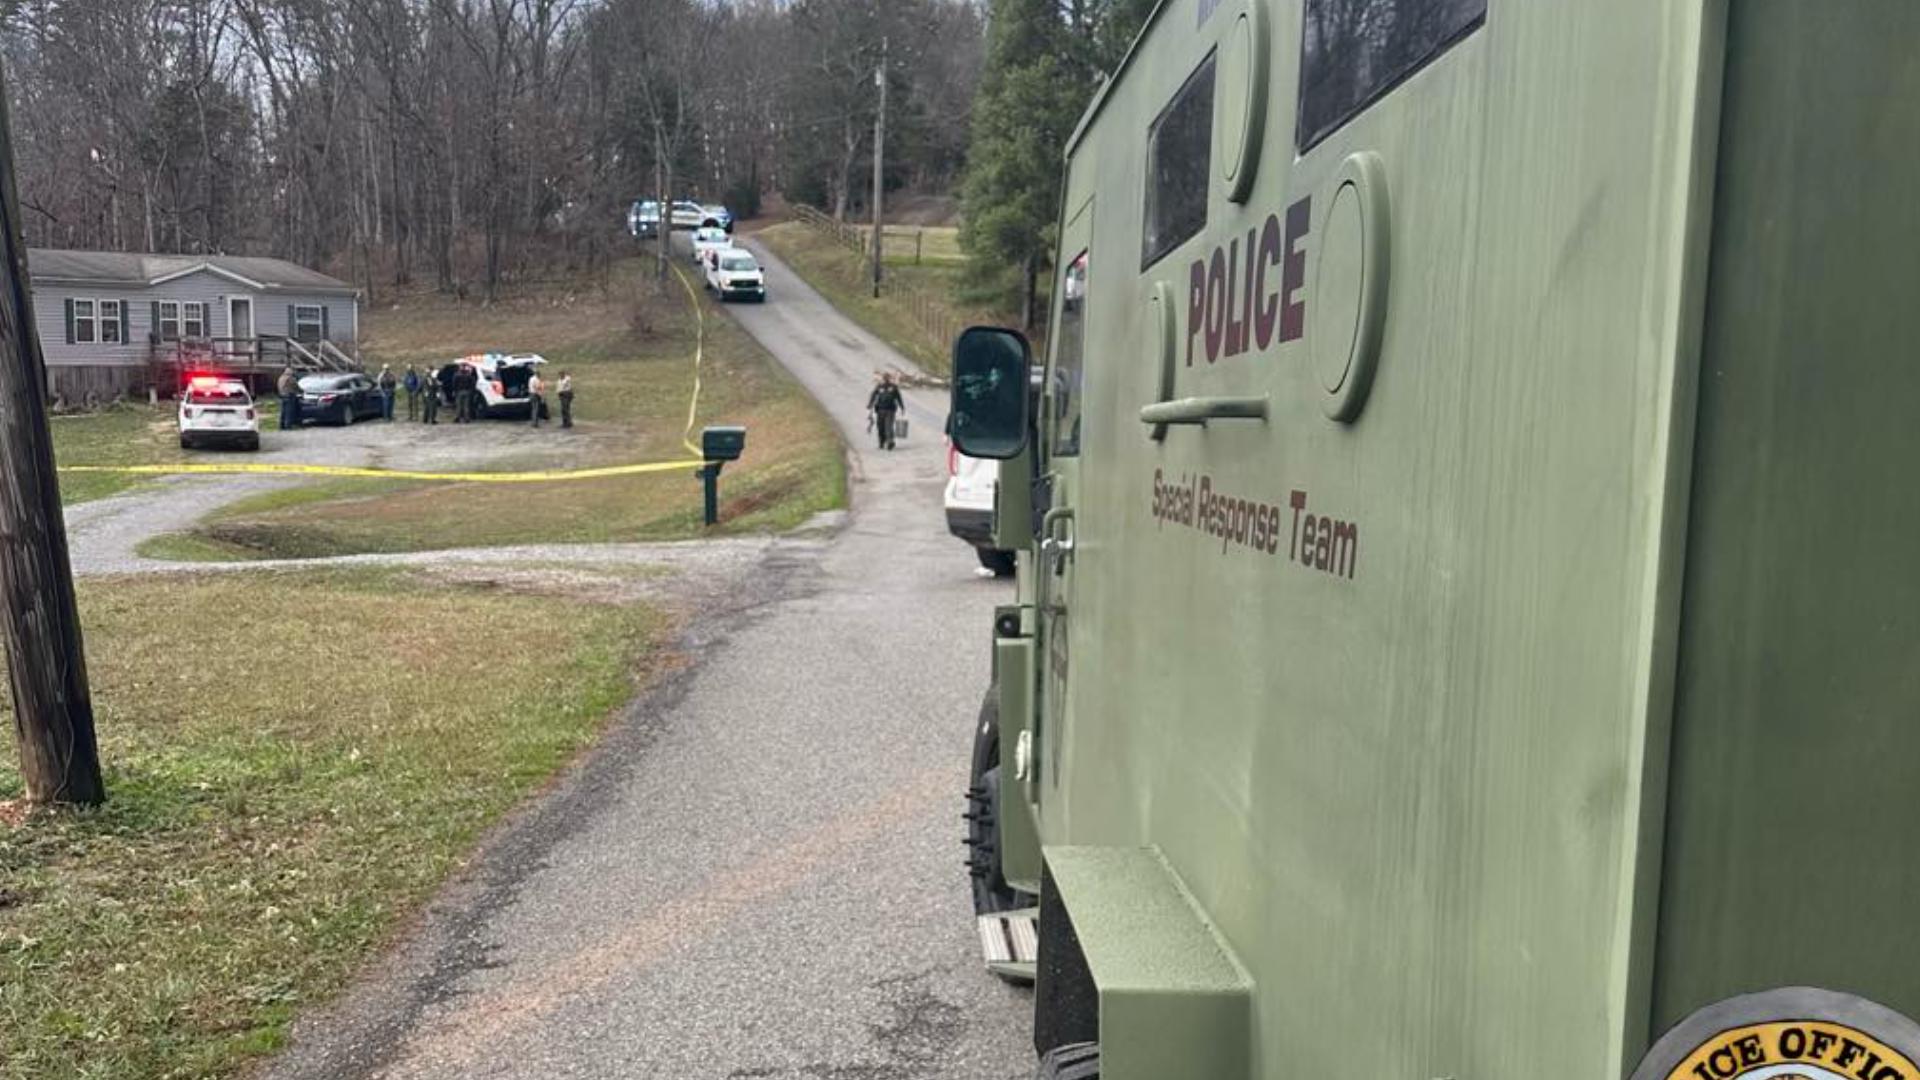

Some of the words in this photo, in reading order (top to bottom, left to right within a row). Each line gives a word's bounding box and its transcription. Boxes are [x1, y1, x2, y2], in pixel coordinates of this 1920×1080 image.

[1186, 195, 1311, 367] POLICE
[1152, 468, 1197, 532] Special
[1197, 475, 1280, 555] Response
[1289, 489, 1358, 580] Team
